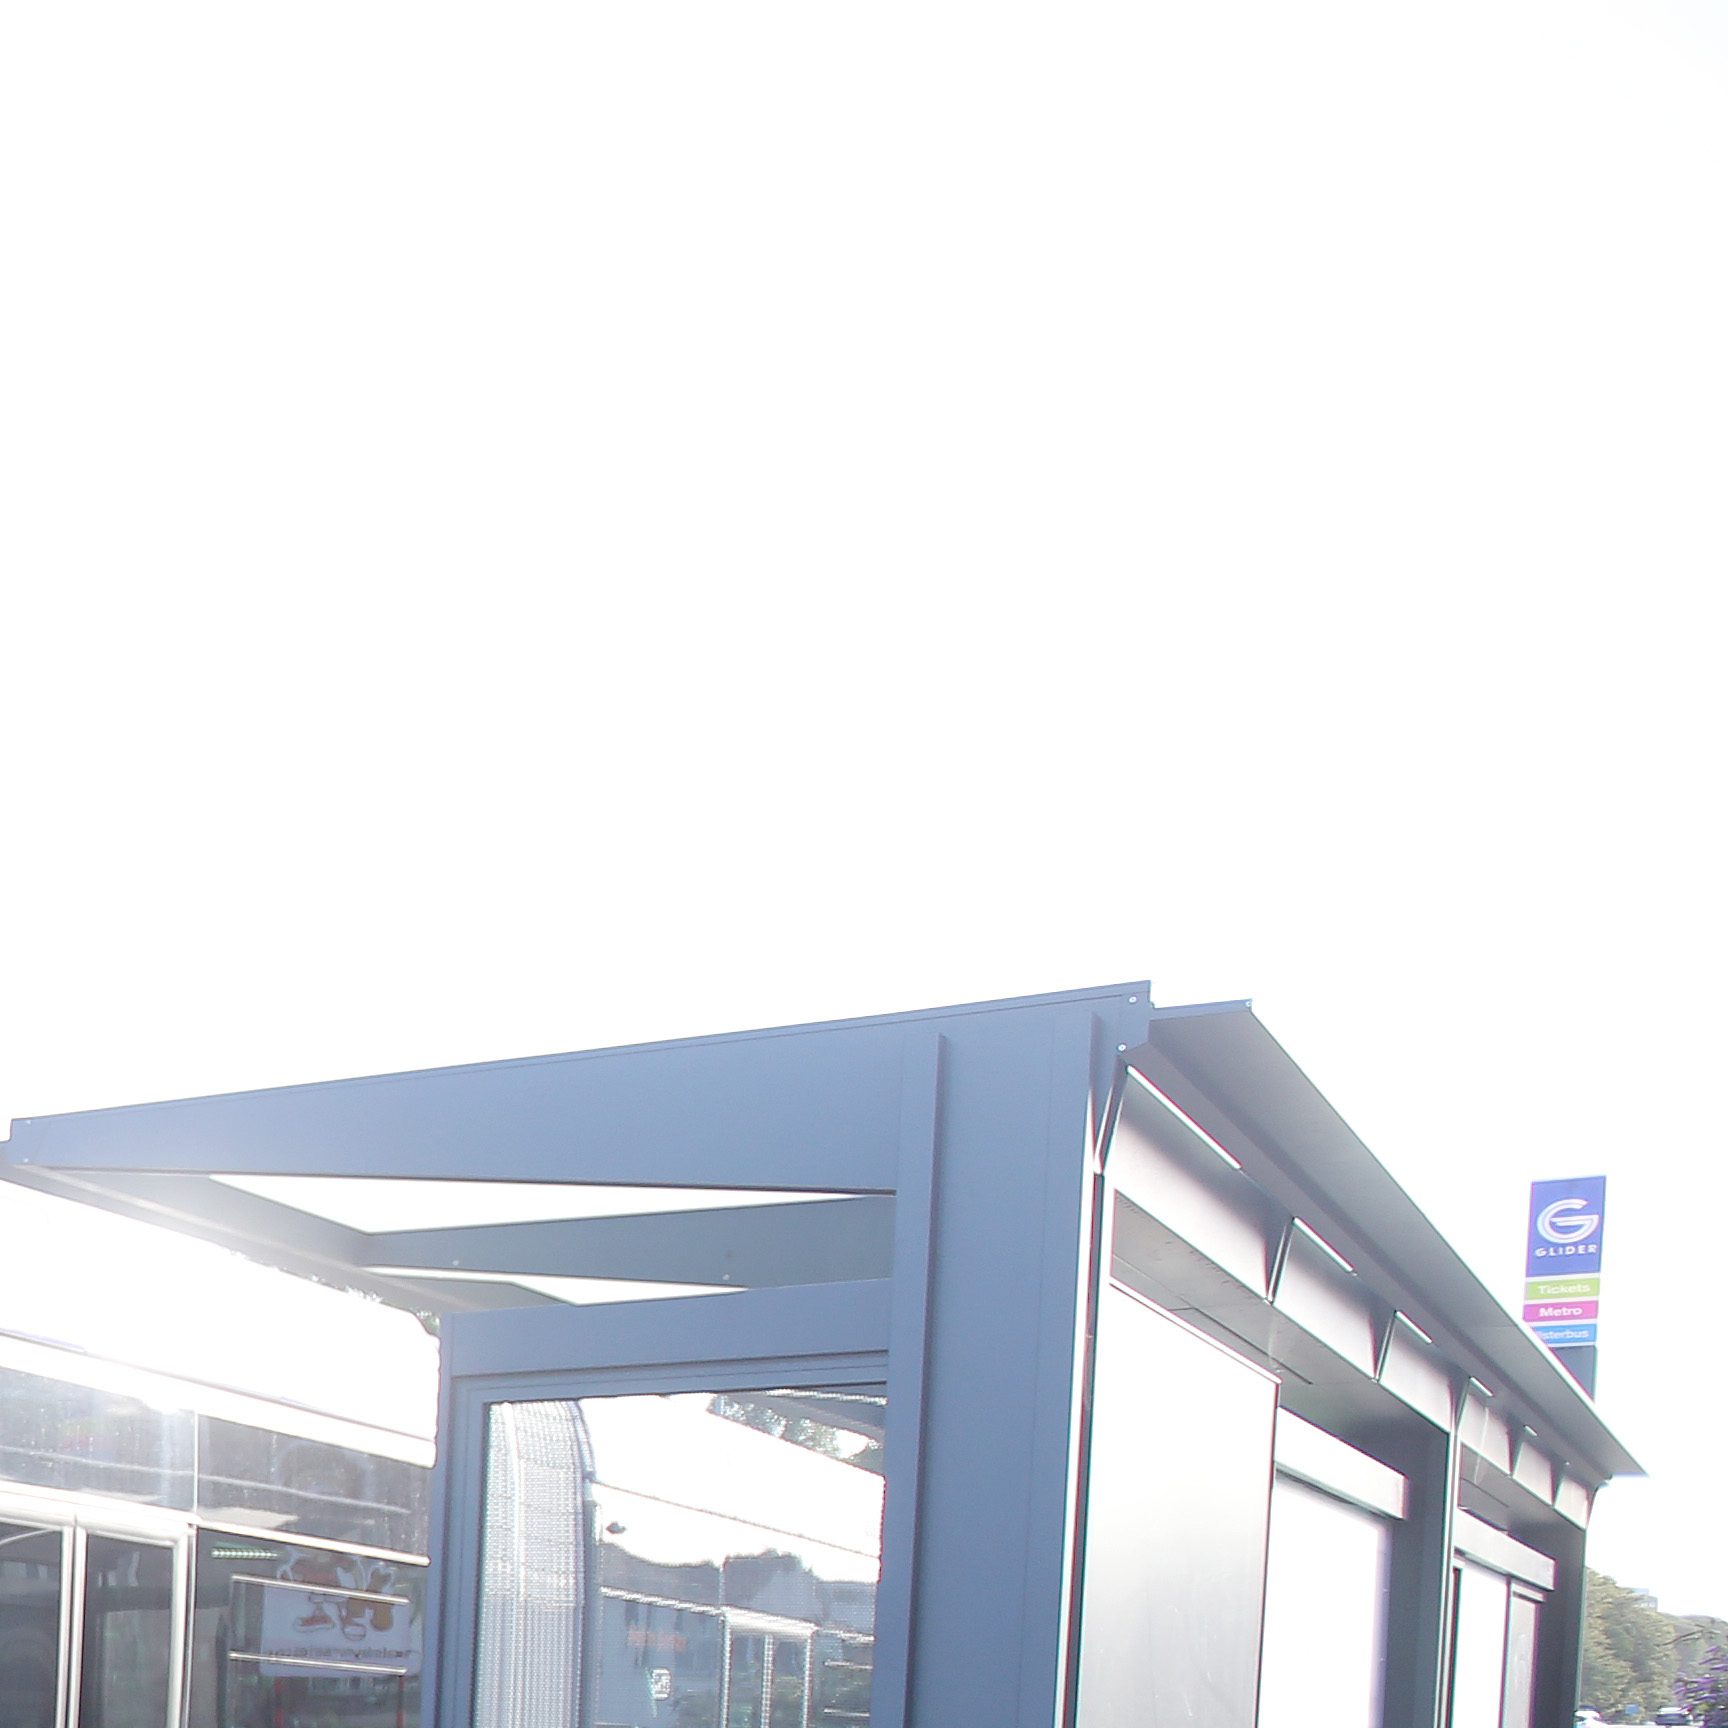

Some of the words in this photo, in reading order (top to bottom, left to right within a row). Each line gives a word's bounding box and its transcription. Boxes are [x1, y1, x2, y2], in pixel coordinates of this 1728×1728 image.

[1535, 1244, 1598, 1257] GLIDER
[1537, 1283, 1591, 1295] Tickets
[1538, 1306, 1583, 1318] Metro
